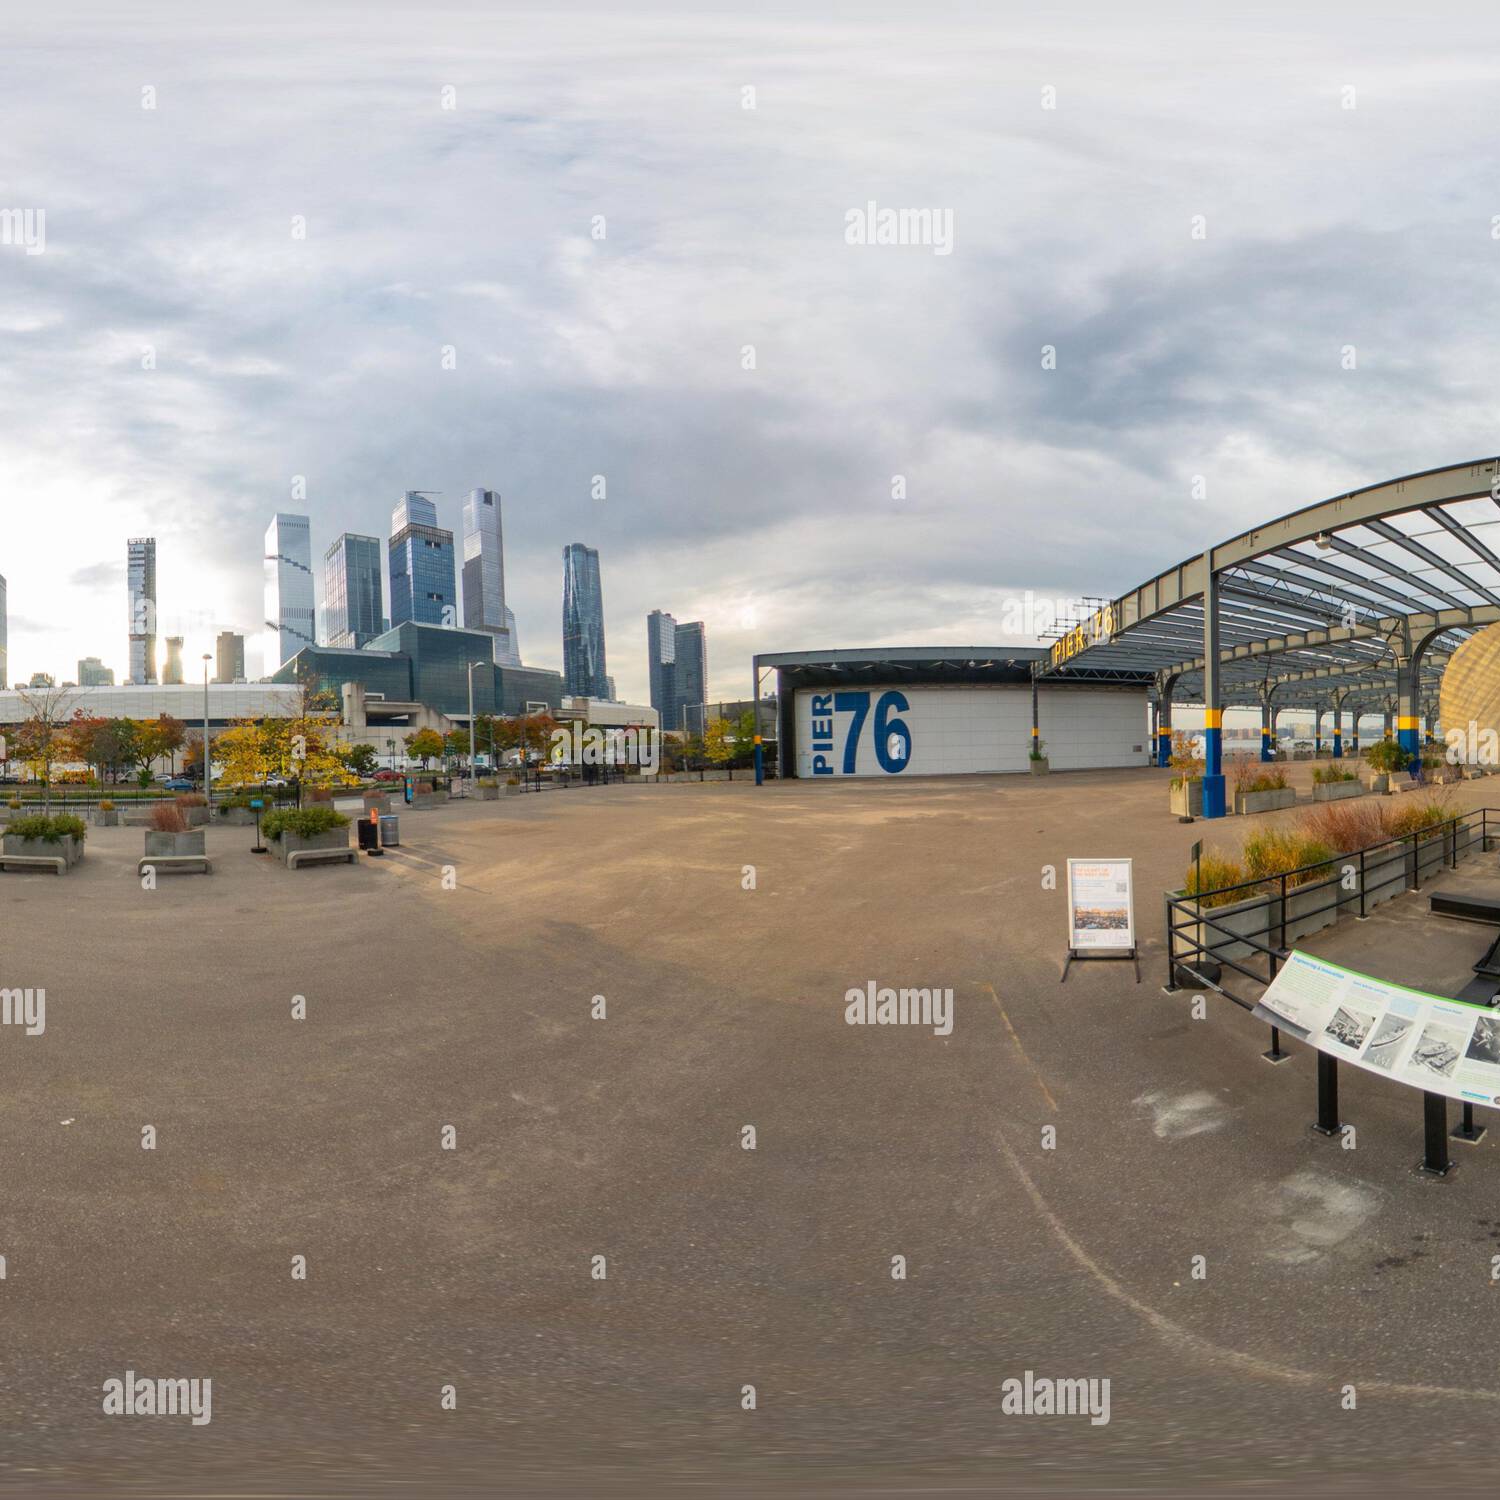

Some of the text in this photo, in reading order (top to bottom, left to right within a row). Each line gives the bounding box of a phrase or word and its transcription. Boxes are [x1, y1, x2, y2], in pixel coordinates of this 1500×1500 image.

[1055, 606, 1114, 665] PIER 76
[811, 693, 834, 775] PIER
[834, 690, 912, 774] 76
